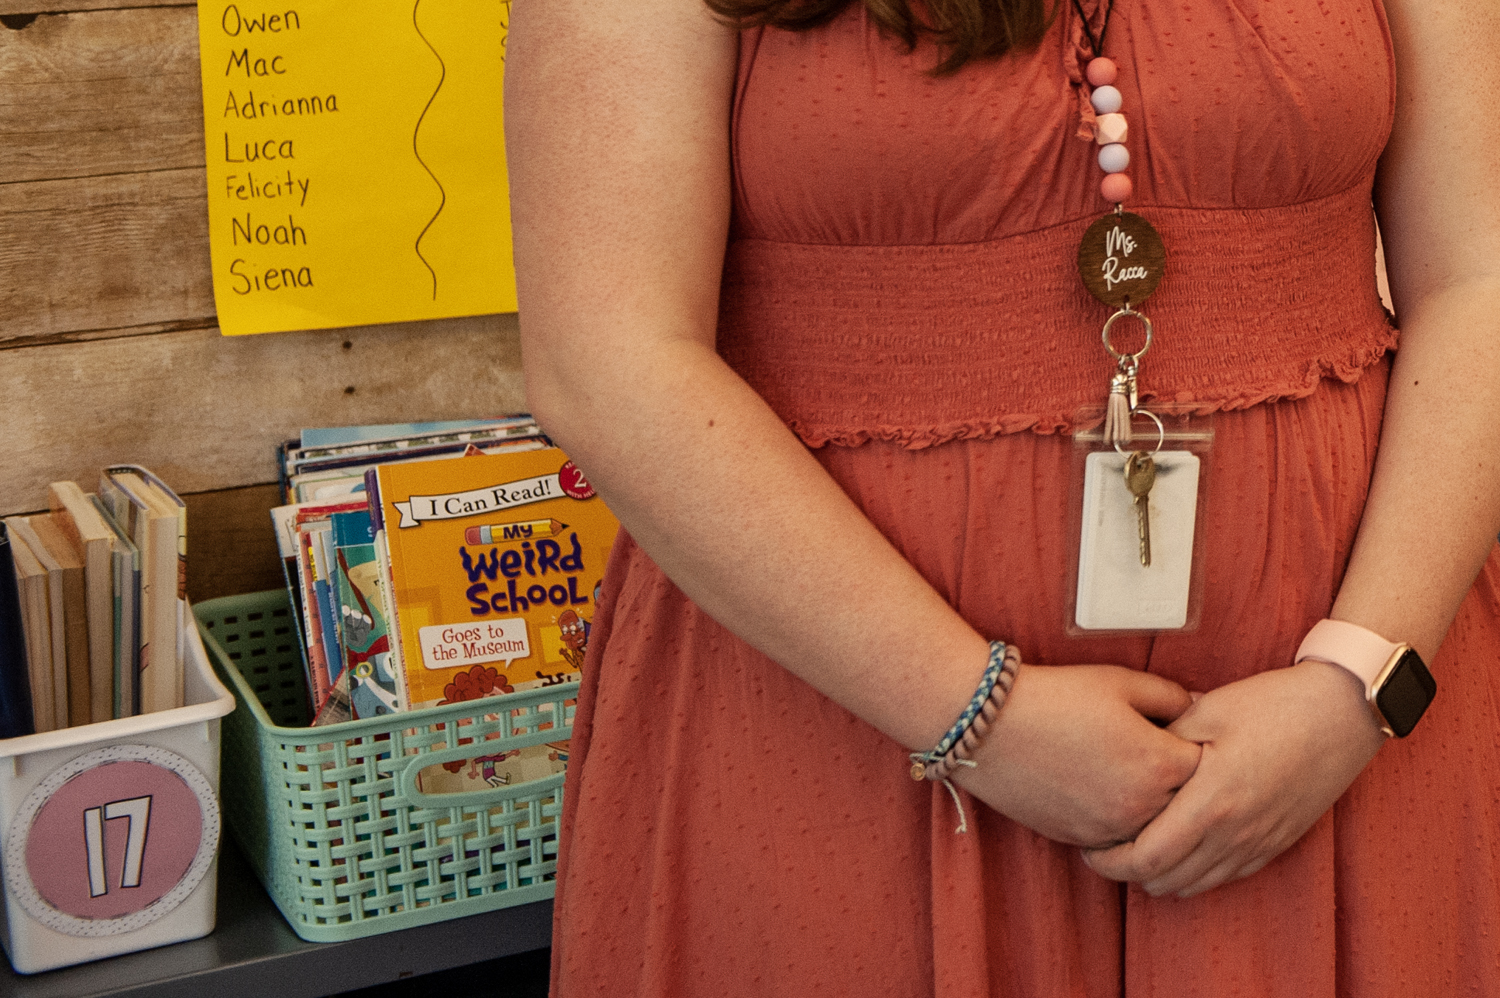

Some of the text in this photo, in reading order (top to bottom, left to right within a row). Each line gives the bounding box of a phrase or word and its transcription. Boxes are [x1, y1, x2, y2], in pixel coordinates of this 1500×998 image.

[222, 3, 300, 37] Owen
[225, 47, 287, 78] Mac
[224, 90, 339, 120] Adrianna
[224, 132, 295, 163] Luca
[226, 170, 310, 207] Felicity
[232, 213, 307, 246] Noah
[1105, 225, 1138, 258] Ms.
[230, 259, 314, 295] Siena
[1101, 256, 1148, 291] Racca
[572, 468, 587, 488] 2
[430, 478, 552, 516] I Can Read!
[503, 524, 533, 540] My
[432, 640, 525, 661] the Museum
[442, 625, 504, 645] Goes to
[83, 794, 152, 898] 17
